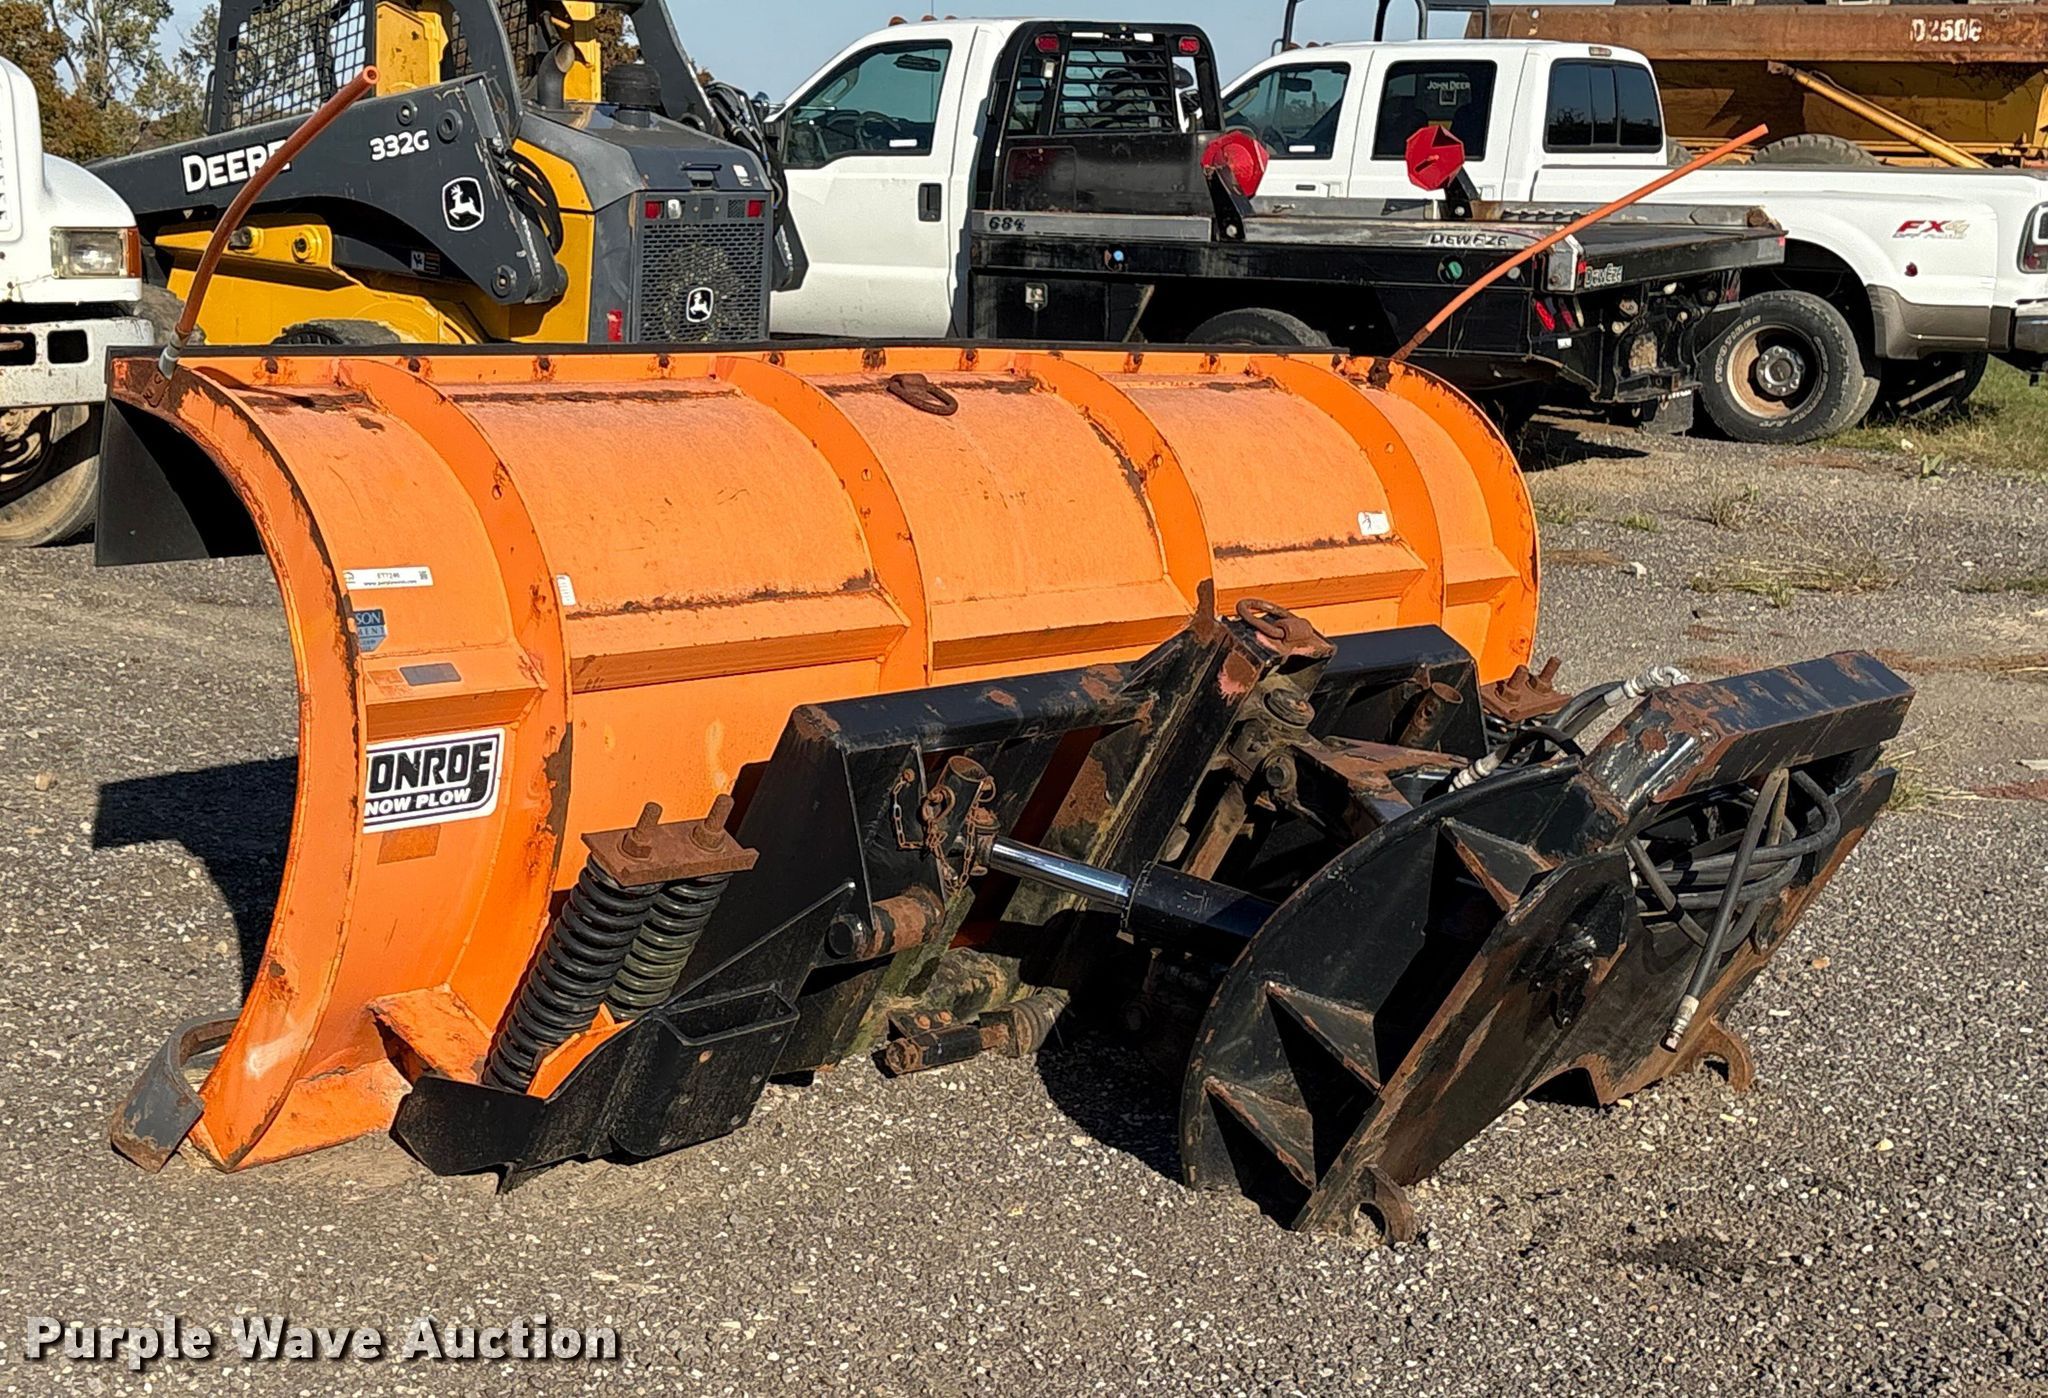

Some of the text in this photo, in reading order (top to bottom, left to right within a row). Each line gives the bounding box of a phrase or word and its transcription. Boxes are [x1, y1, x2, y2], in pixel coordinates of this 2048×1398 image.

[370, 130, 430, 161] 332G
[366, 741, 493, 801] ONROE
[416, 787, 472, 809] PLOW
